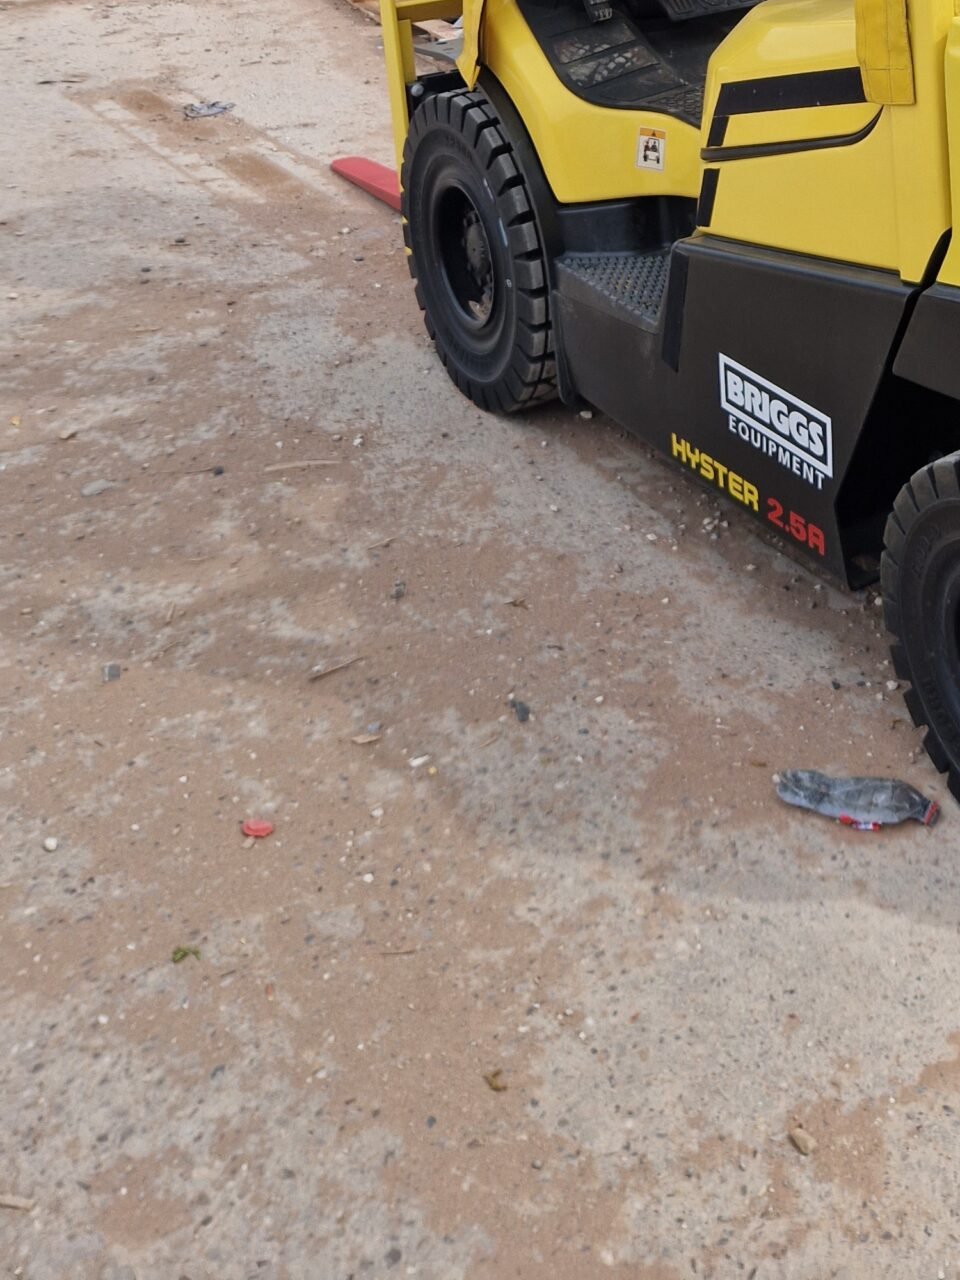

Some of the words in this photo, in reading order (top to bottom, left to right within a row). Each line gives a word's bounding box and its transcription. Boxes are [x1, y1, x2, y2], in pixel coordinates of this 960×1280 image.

[725, 369, 825, 458] BRIGGS
[728, 414, 826, 490] EQUIPMENT
[670, 432, 760, 513] HYSTER
[766, 497, 826, 557] 2.5A
